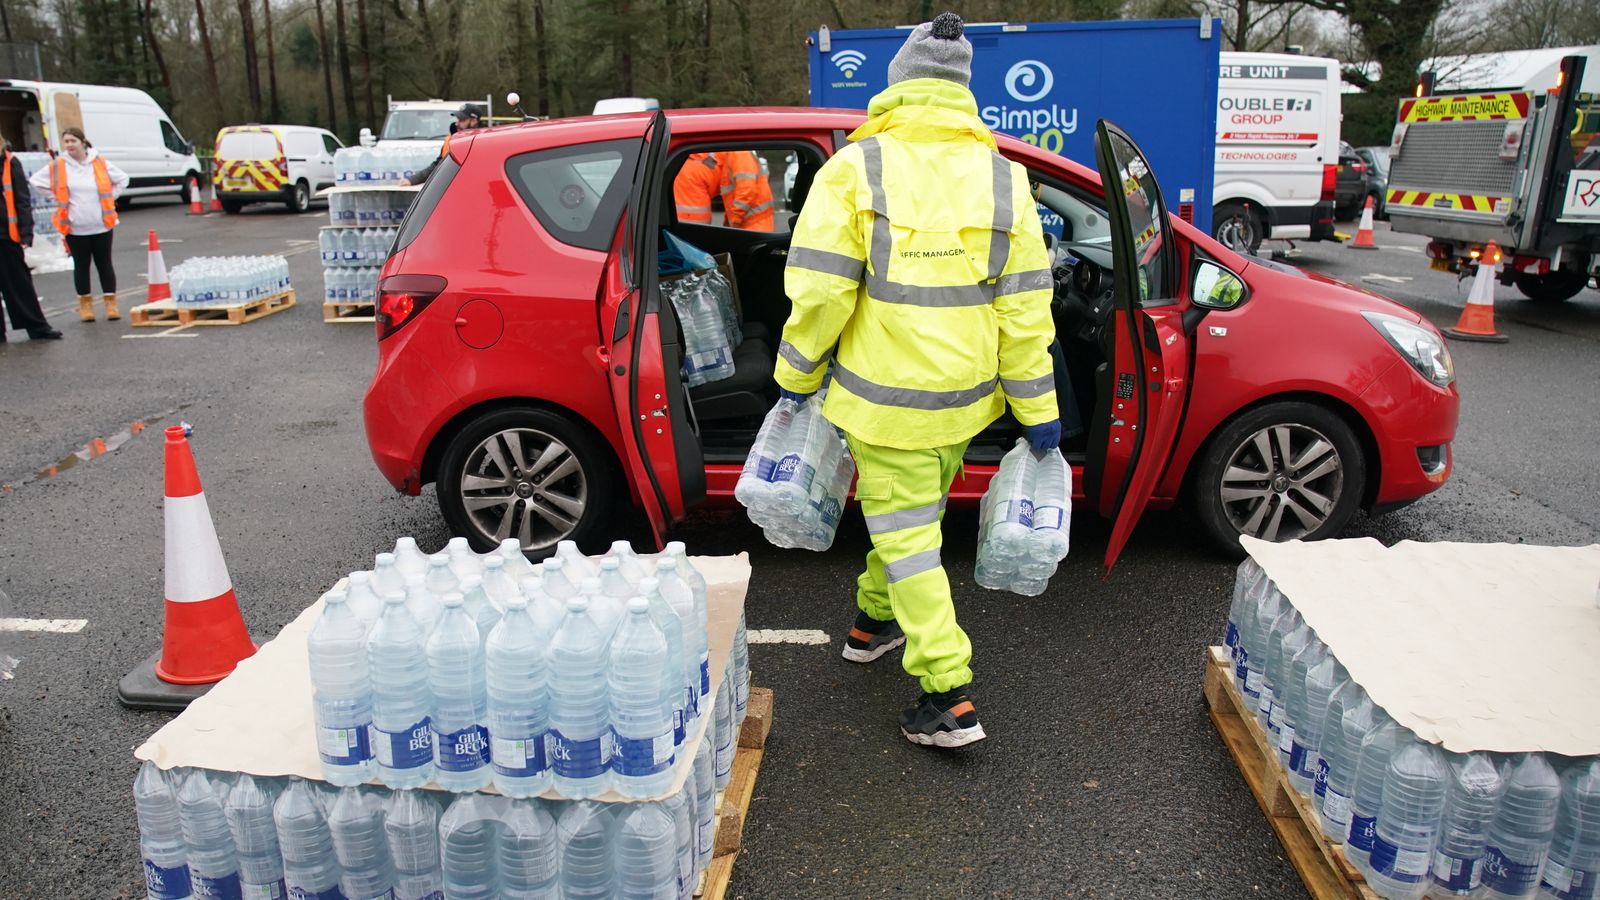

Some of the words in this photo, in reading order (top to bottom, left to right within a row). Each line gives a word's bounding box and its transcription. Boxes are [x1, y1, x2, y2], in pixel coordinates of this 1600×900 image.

[1220, 66, 1241, 78] RE
[1249, 66, 1289, 78] UNIT
[1220, 97, 1284, 111] OUBLE
[1415, 103, 1448, 116] HIGHWAY
[1450, 100, 1510, 115] MAINTENANCE
[981, 104, 1078, 134] Simply
[1231, 114, 1283, 125] GROUP
[1220, 152, 1297, 160] TECHNOLOGIES
[922, 248, 965, 258] MANAGEM
[455, 737, 488, 755] BECK
